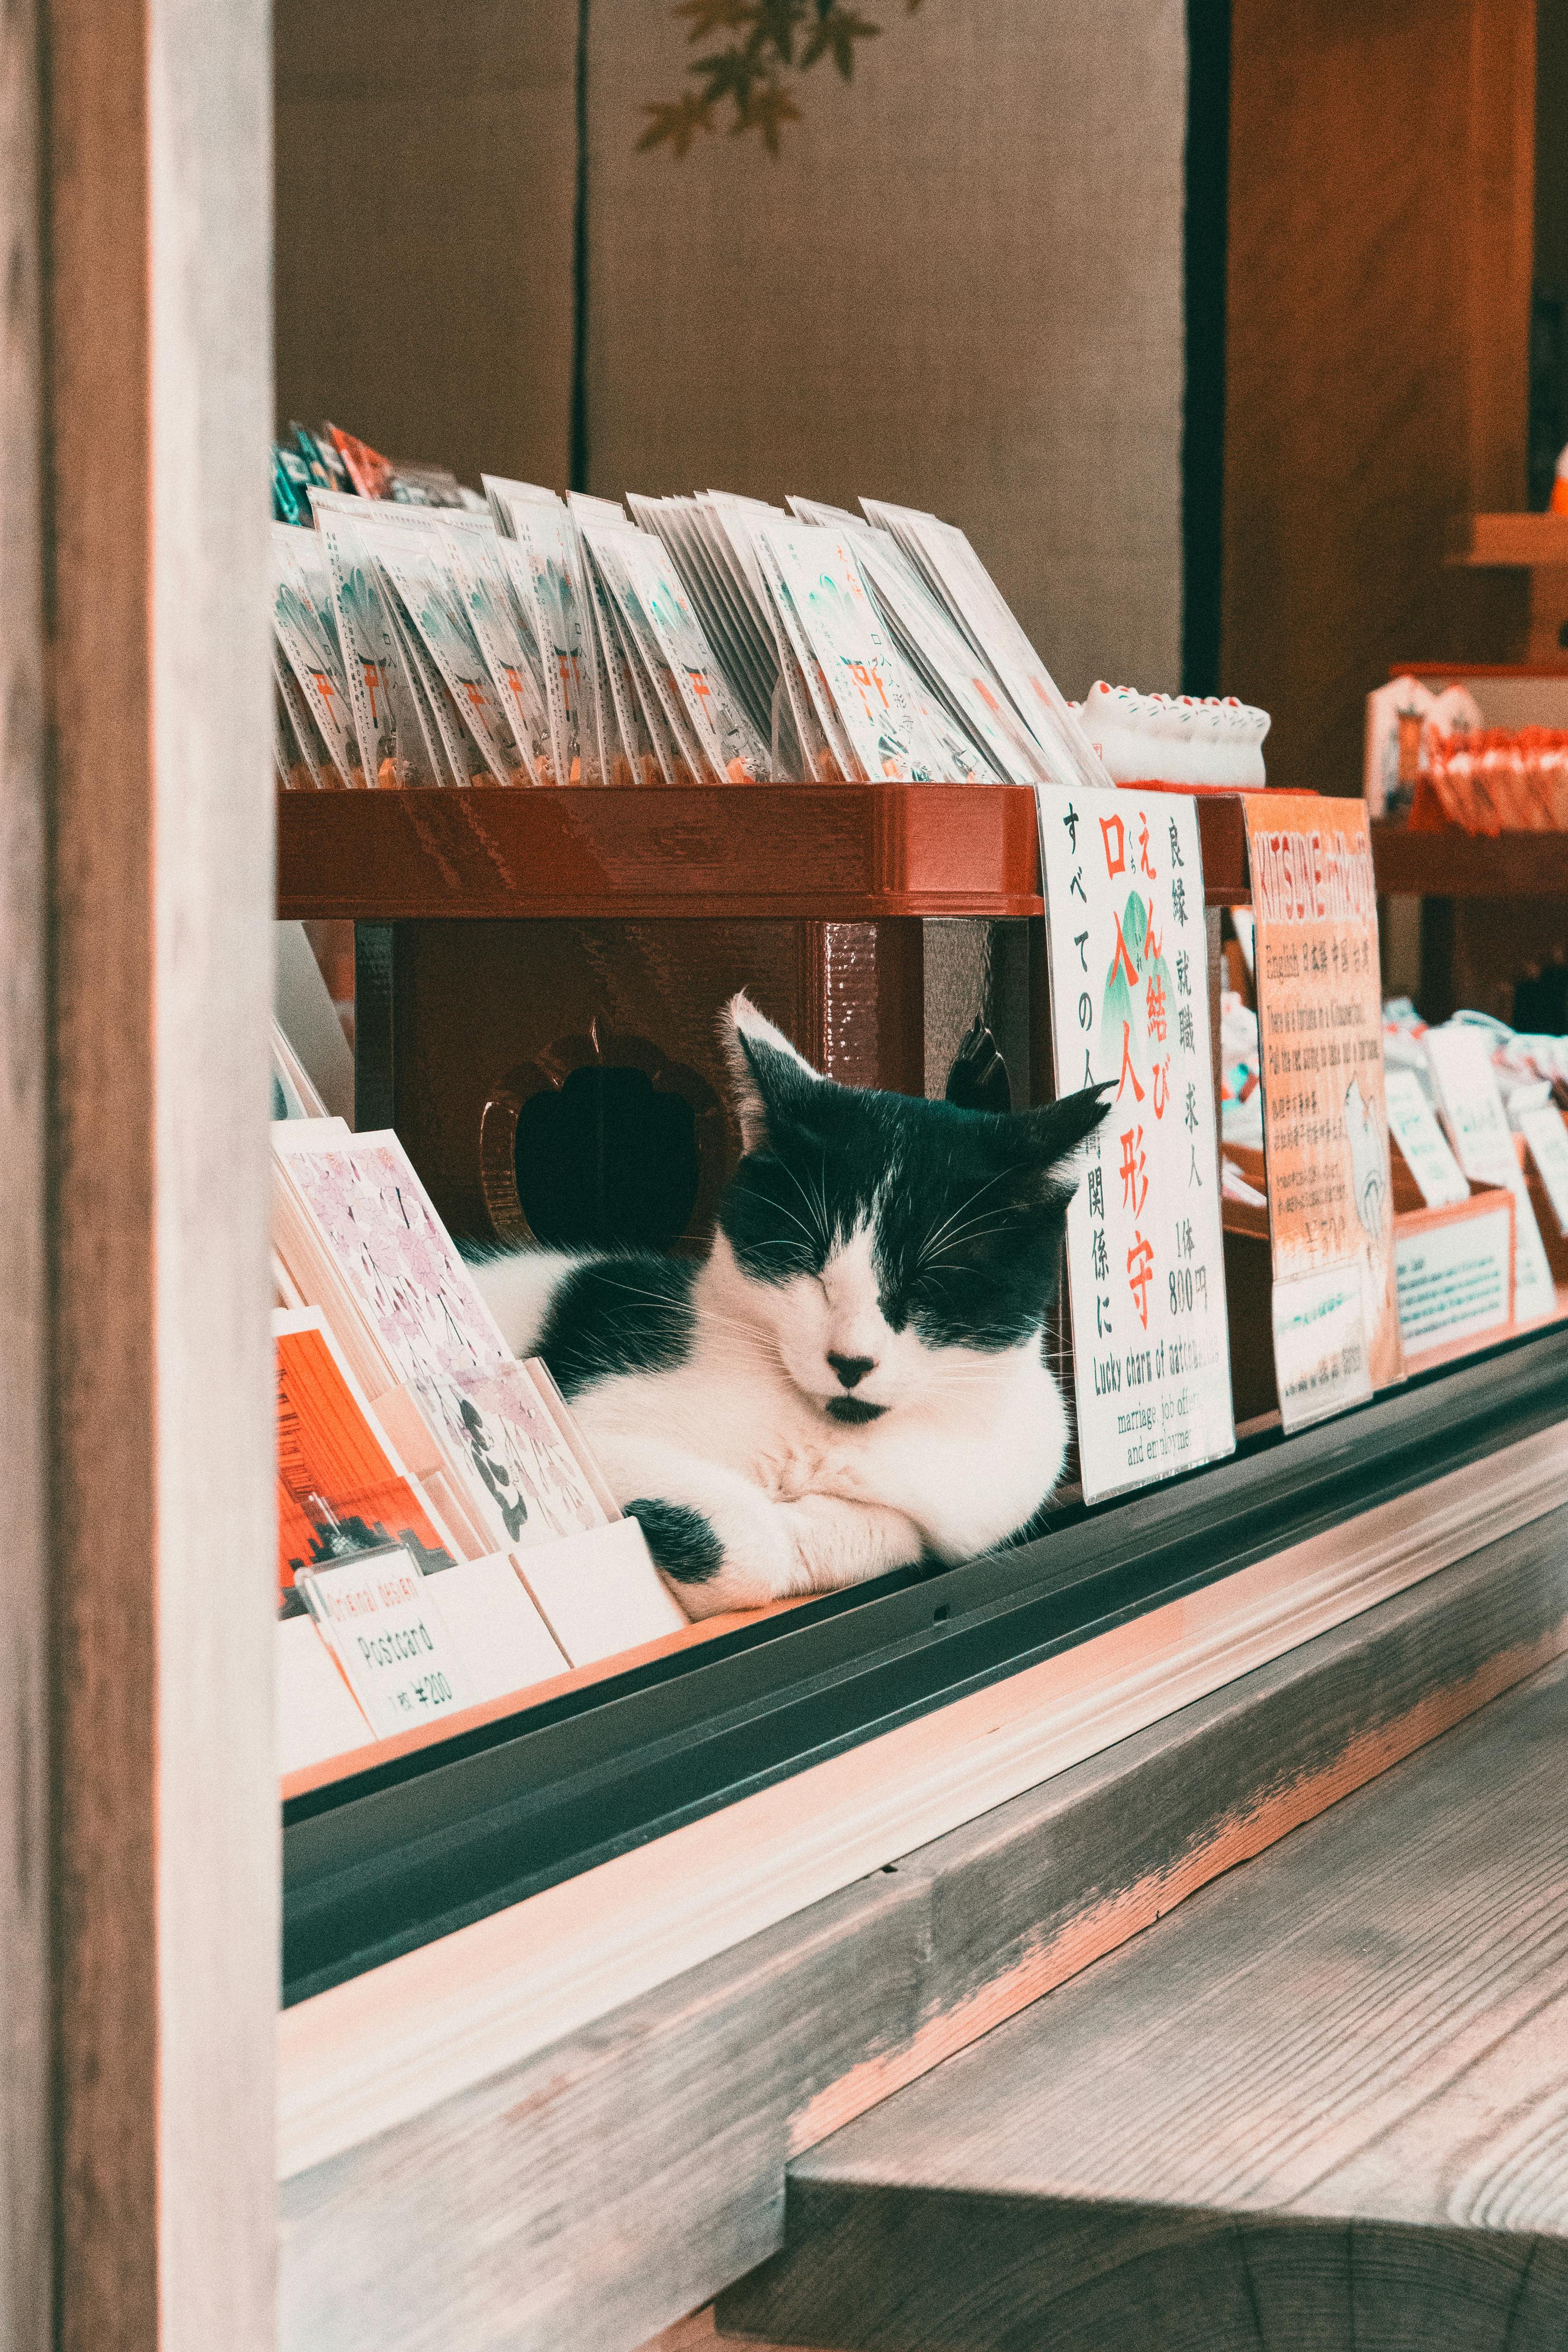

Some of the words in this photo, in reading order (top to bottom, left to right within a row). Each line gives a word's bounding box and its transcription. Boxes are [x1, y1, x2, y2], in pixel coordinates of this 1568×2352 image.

[1254, 831, 1325, 925] KITSUNE
[1138, 811, 1171, 1120] えん結び
[1266, 944, 1299, 984] English
[1099, 813, 1154, 1331] 口入人形守
[1169, 1265, 1208, 1315] 800円
[1093, 1352, 1121, 1396] Lucky
[1126, 1346, 1153, 1387] charm
[1155, 1339, 1164, 1379] of
[1161, 1394, 1175, 1426] job
[1127, 1435, 1144, 1466] and
[357, 1617, 433, 1669] Postcard
[410, 1671, 452, 1709] ¥200
